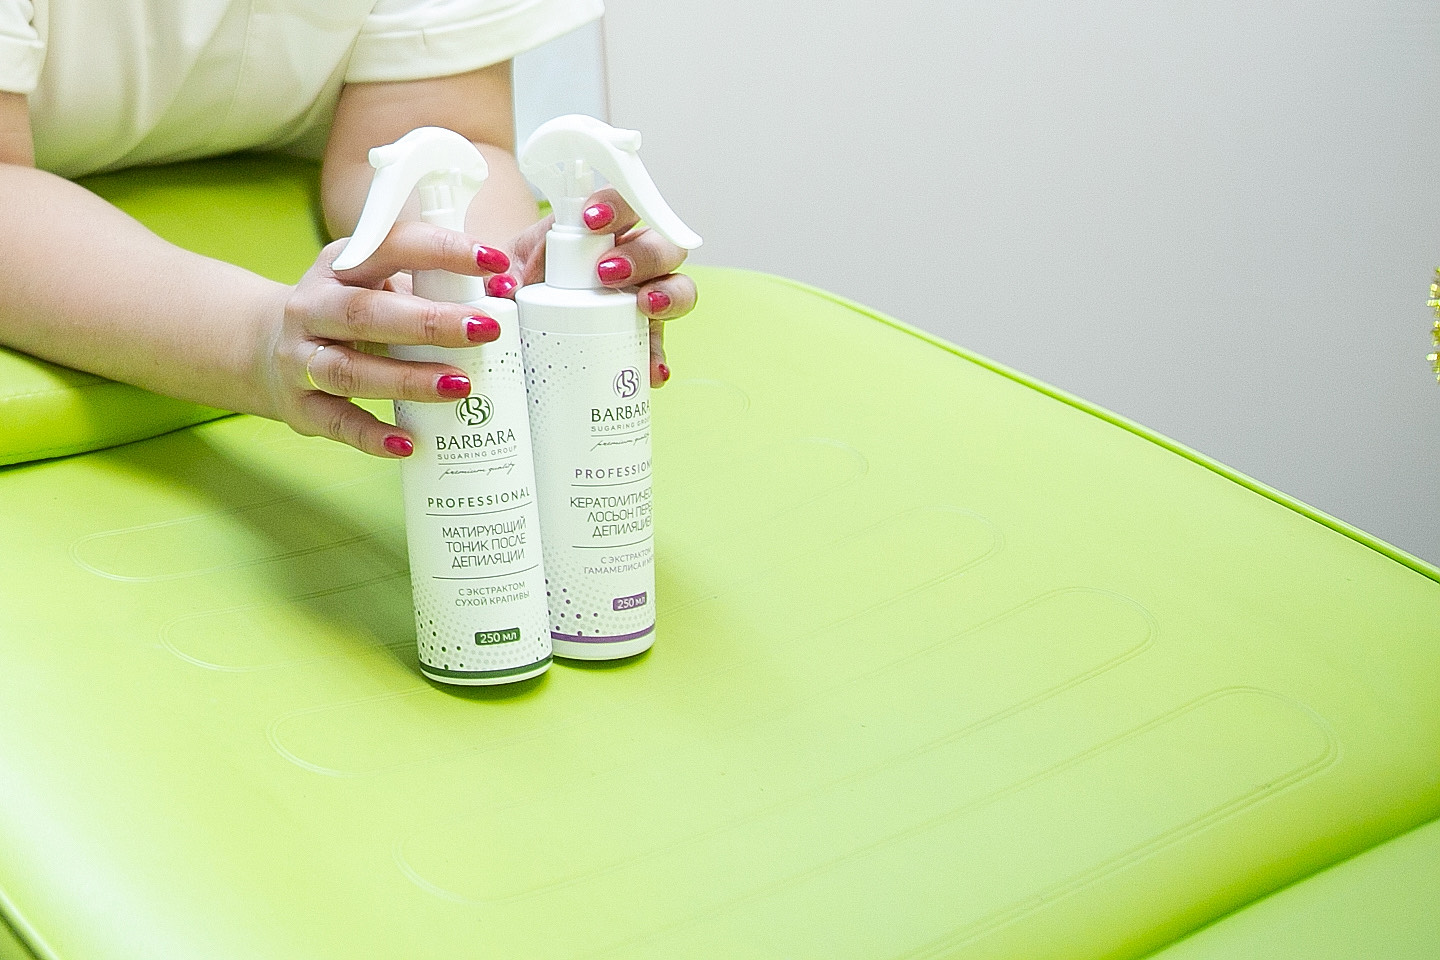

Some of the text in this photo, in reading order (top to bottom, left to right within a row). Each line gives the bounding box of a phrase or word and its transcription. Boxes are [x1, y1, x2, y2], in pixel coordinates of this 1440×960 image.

[590, 422, 635, 432] SUGARING
[435, 428, 516, 450] BARBARA
[437, 445, 518, 461] SUGARING GROUP
[575, 459, 651, 479] PROFESSION
[427, 486, 530, 508] PROFESSIONAL
[587, 508, 634, 522] ЛОСЬОН
[441, 515, 527, 538] МАТИРУЮЩИЙ
[445, 532, 526, 553] ТОНИК ПОСЛЕ
[452, 548, 525, 569] ДЕПИЛЯЦИИ
[584, 562, 641, 574] ГАМАМЕЛИСА
[467, 581, 525, 596] ЭКСТРАКТОМ
[455, 591, 530, 607] СУХОЙ КРАПИВЫ
[617, 598, 635, 609] 250
[479, 631, 517, 644] 250 мл
